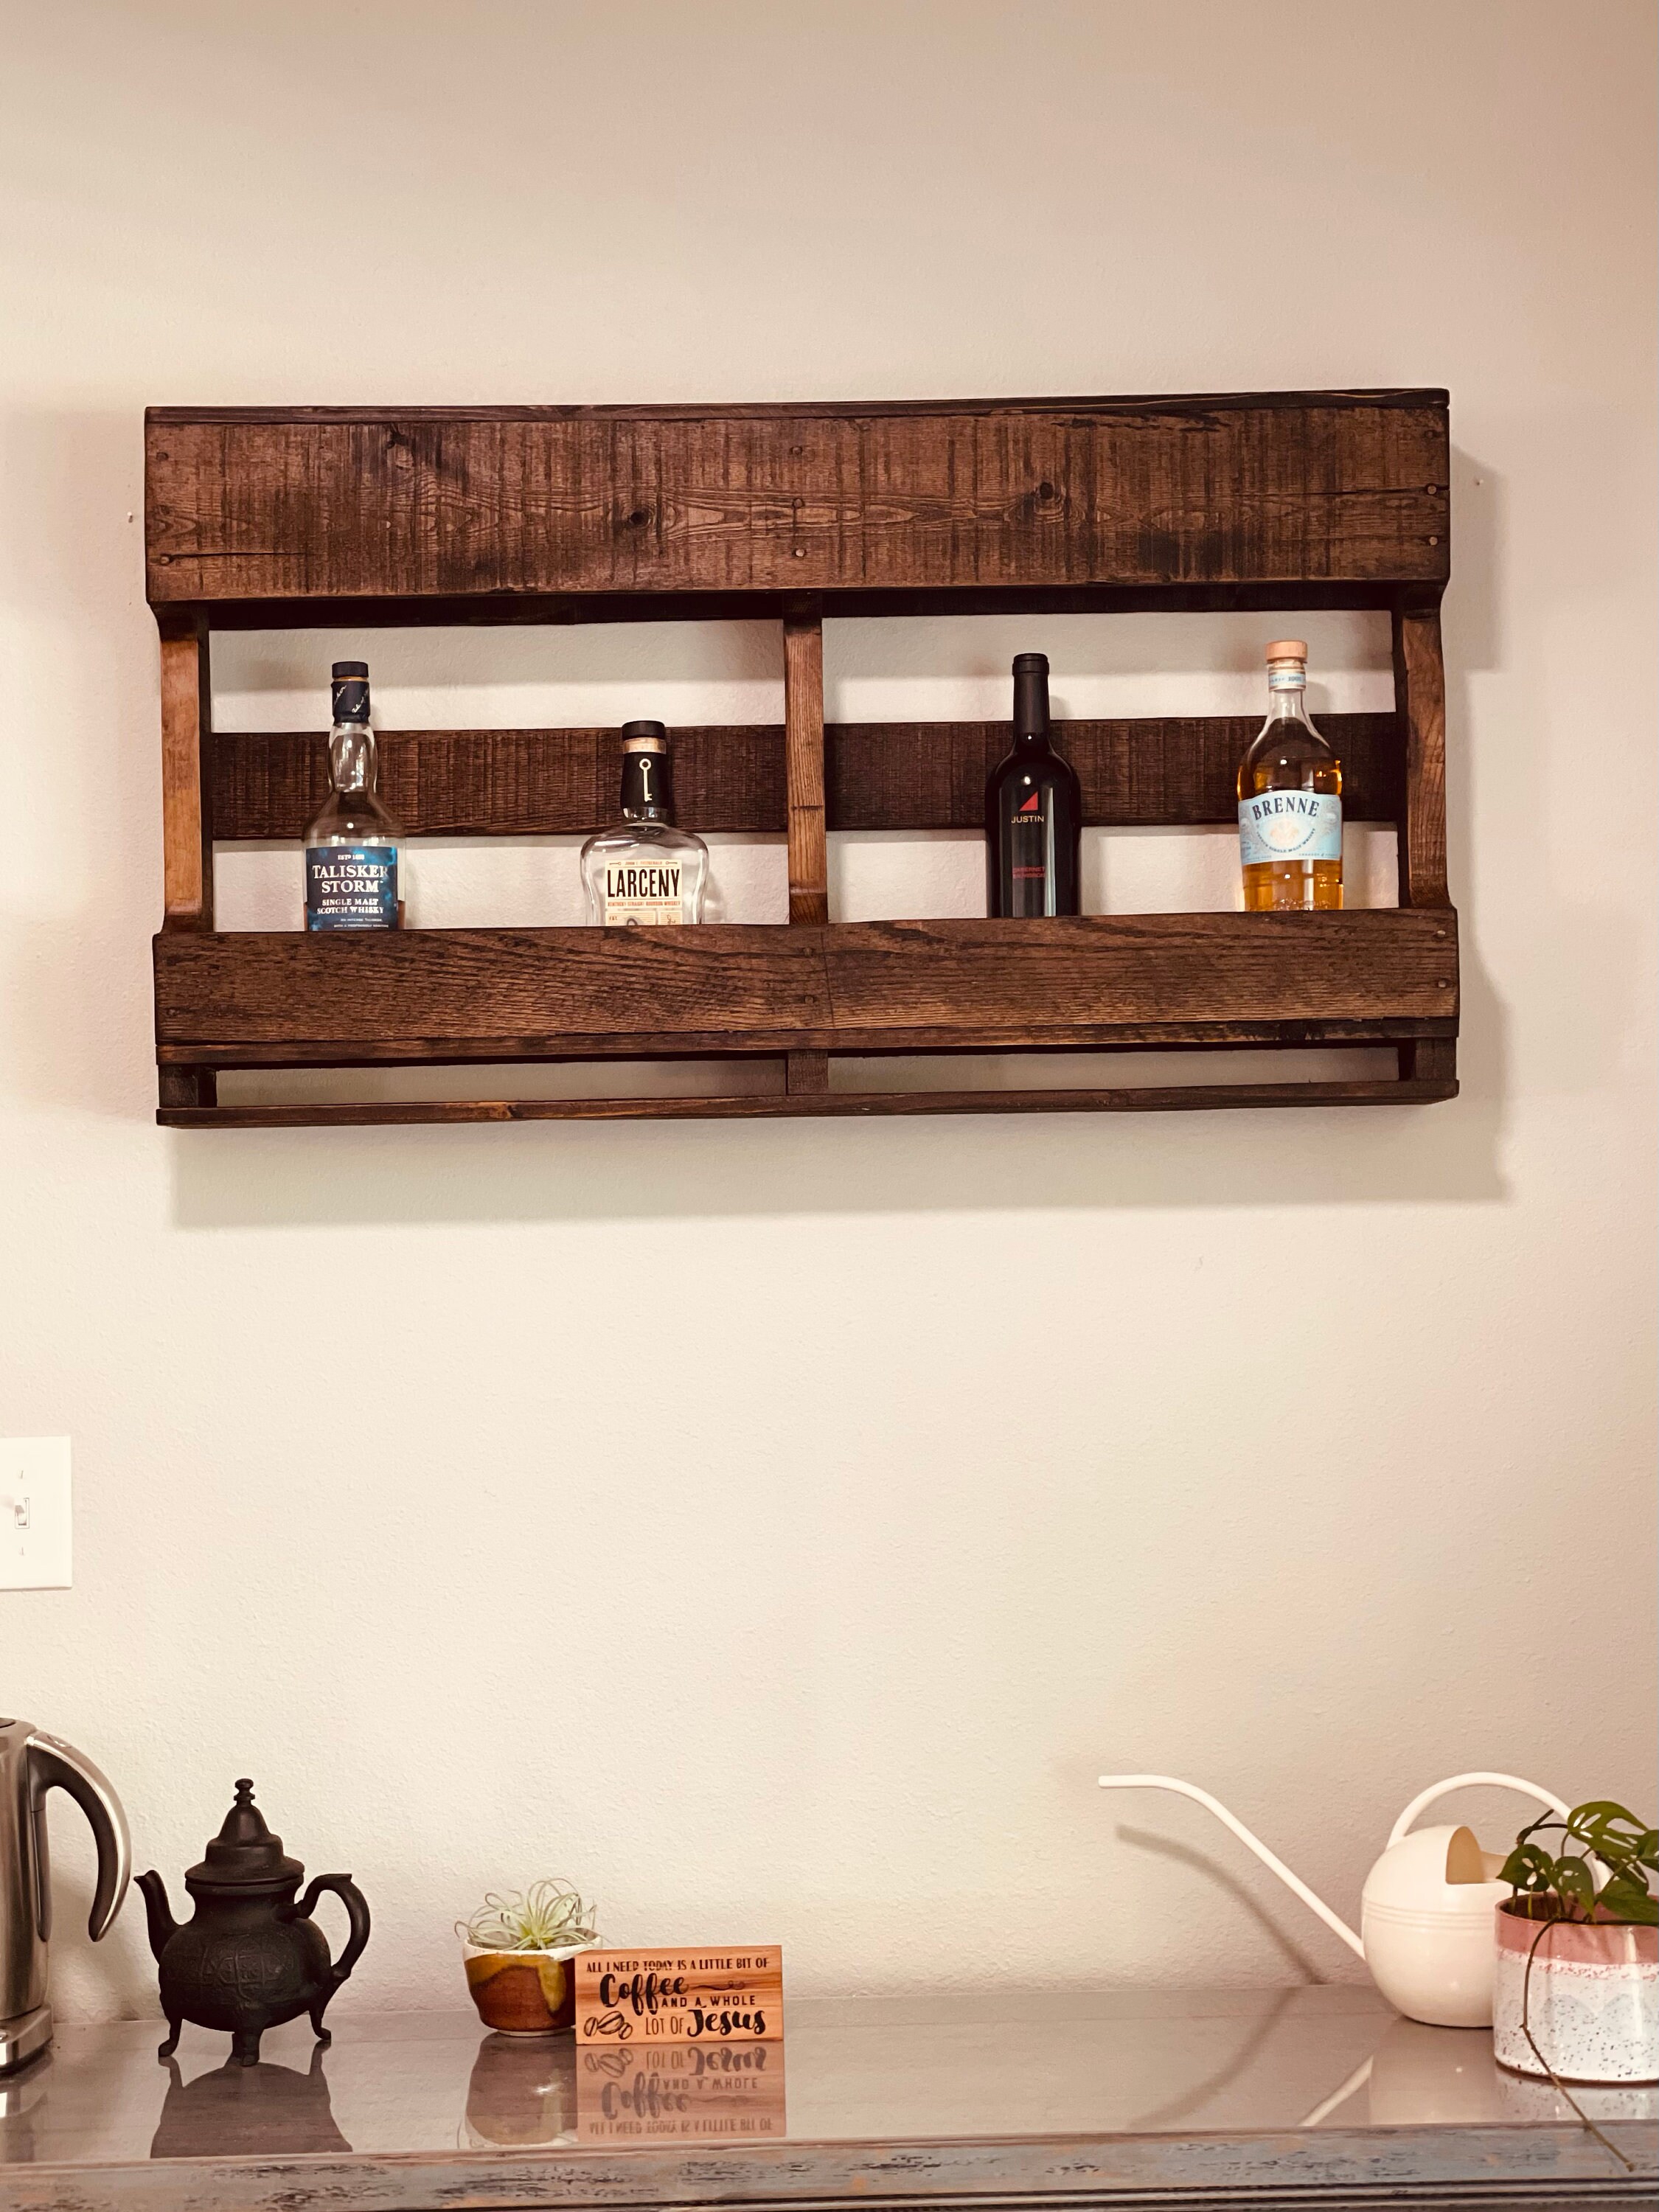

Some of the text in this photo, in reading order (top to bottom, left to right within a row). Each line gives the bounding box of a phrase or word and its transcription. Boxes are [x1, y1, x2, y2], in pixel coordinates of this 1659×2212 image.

[1252, 797, 1320, 820] BRENNE
[1011, 815, 1045, 824] JUSTIN
[312, 865, 389, 878] TALISKER
[321, 880, 379, 893] STORM
[608, 869, 680, 897] LARCENY
[587, 1958, 770, 1973] ALL I NEED TODAY IS A LITTLE BIT OF
[599, 1972, 689, 2016] Coffee
[661, 1995, 756, 2008] AND A WHOLE
[645, 2009, 766, 2037] LOT OF Jesus
